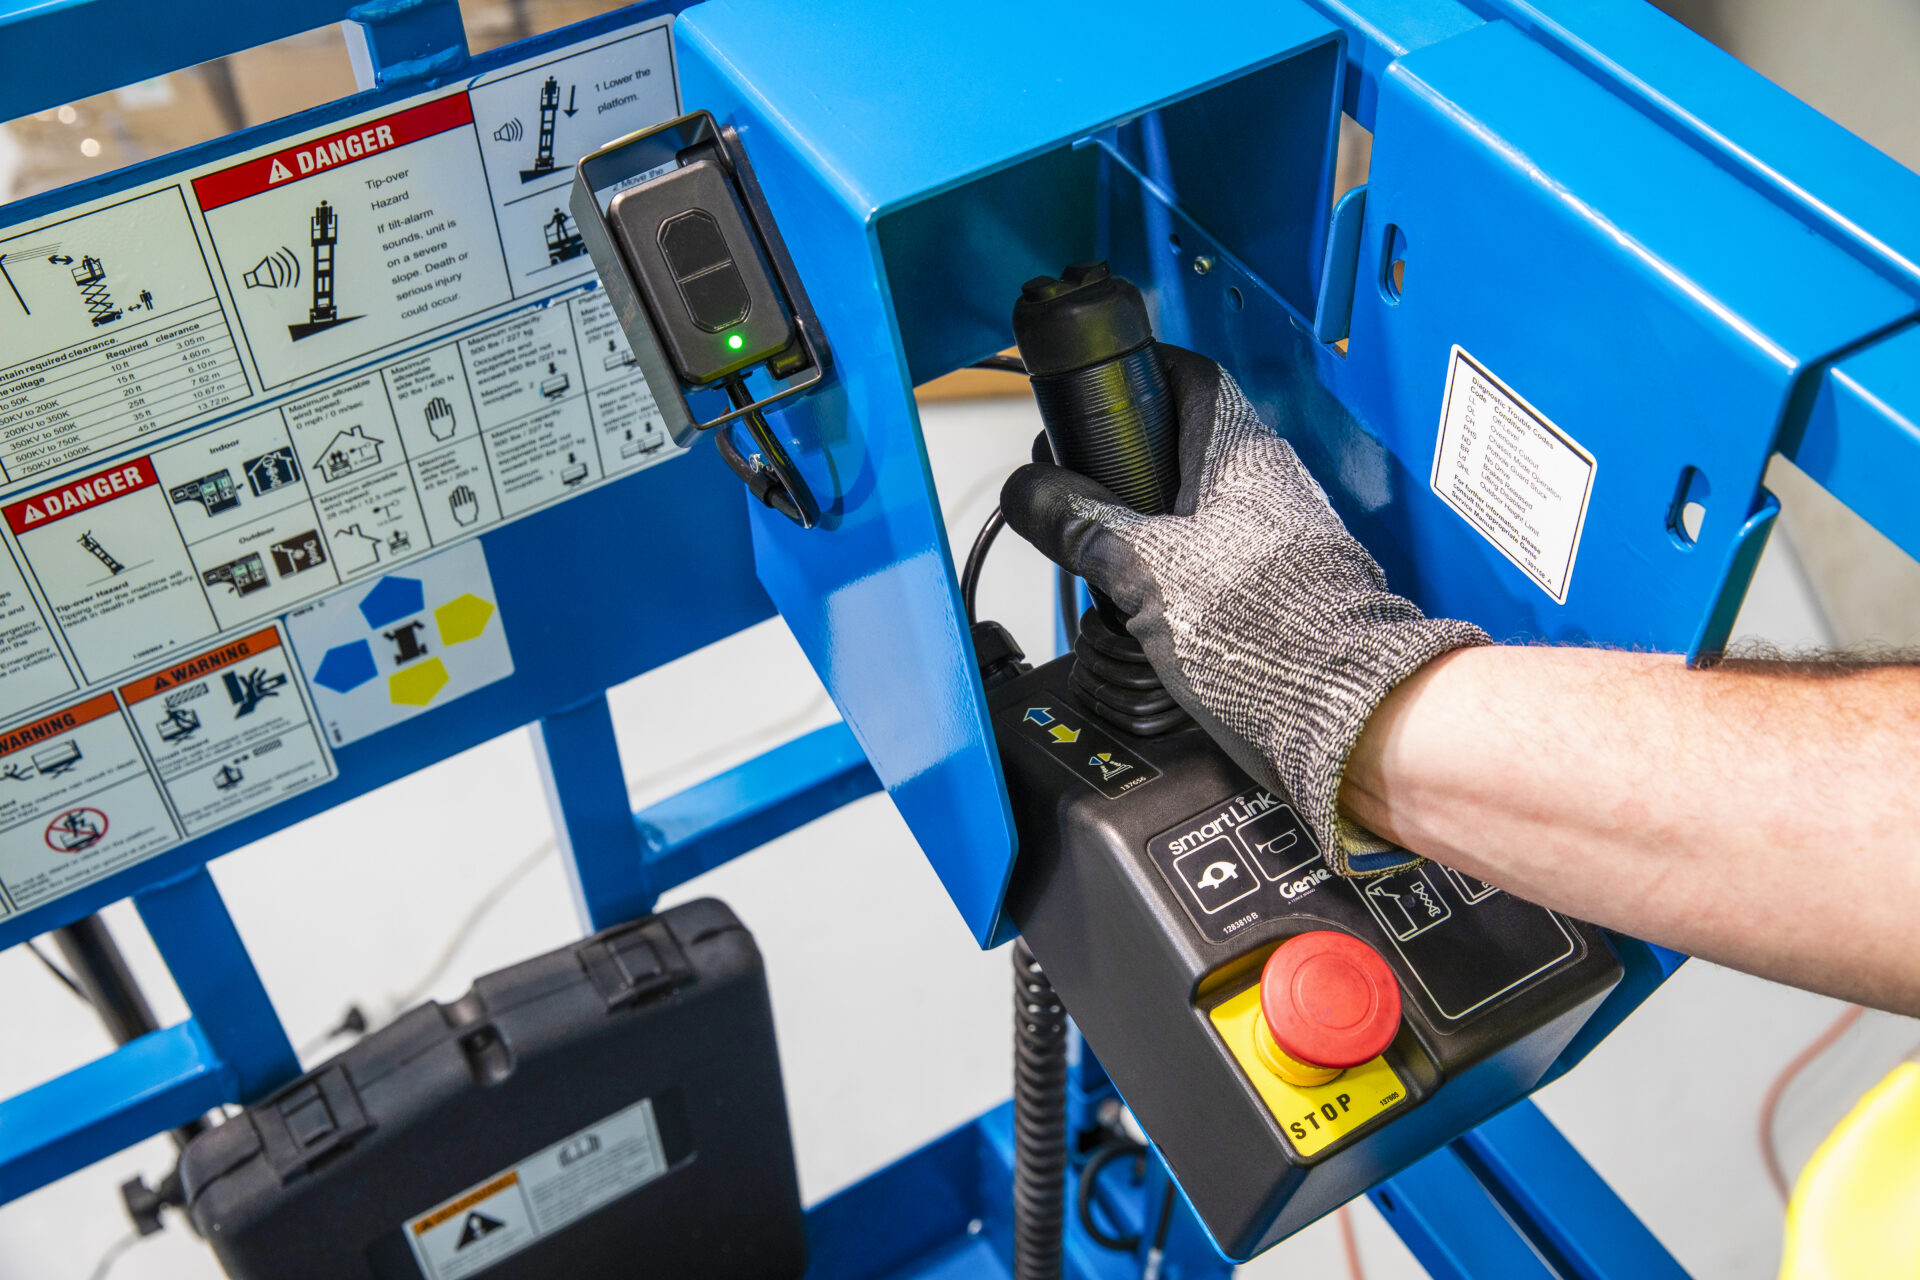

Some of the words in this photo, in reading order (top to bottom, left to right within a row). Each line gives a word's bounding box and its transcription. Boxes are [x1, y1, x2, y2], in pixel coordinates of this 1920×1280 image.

[595, 83, 600, 92] 1
[603, 74, 632, 90] Lower
[635, 68, 650, 79] the
[597, 93, 637, 114] platform.
[296, 124, 394, 173] DANGER
[365, 169, 408, 189] Tip-over
[370, 190, 409, 210] Hazard
[377, 223, 384, 233] If
[388, 209, 433, 230] tilt-alarm
[382, 232, 423, 251] sounds,
[425, 222, 445, 235] unit
[447, 220, 456, 228] is
[386, 258, 400, 268] on
[403, 254, 410, 262] a
[412, 241, 447, 259] severe
[391, 270, 419, 284] slope.
[424, 256, 456, 272] Death
[458, 251, 468, 261] or
[396, 282, 433, 301] serious
[434, 272, 461, 287] injury
[400, 302, 428, 319] could
[430, 293, 458, 308] occur.
[25, 353, 67, 372] required
[68, 338, 118, 358] clearance.
[105, 339, 148, 360] Required
[155, 323, 199, 342] clearance
[111, 363, 122, 371] 10
[176, 337, 195, 349] 3.05
[117, 375, 128, 384] 15
[182, 350, 201, 360] 4.60
[192, 374, 209, 385] 7.62
[211, 371, 220, 379] m
[8, 377, 44, 392] voltage
[122, 387, 133, 396] 20
[288, 394, 329, 413] Maximum
[332, 379, 370, 397] allowable
[10, 395, 29, 407] 50K
[34, 399, 59, 413] 200K
[133, 412, 144, 420] 35
[216, 383, 225, 391] m
[138, 424, 149, 432] 45
[220, 395, 229, 403] m
[292, 409, 312, 421] wind
[1470, 385, 1486, 403] Code
[1494, 405, 1525, 435] Condition
[1471, 376, 1505, 408] Diagnostic
[1507, 406, 1531, 430] Trouble
[1532, 428, 1553, 449] Codes
[3, 422, 34, 438] 200KV
[45, 410, 70, 423] 350K
[9, 434, 39, 450] 350KV
[53, 421, 77, 435] 500K
[304, 416, 323, 426] mph
[1466, 404, 1475, 416] OL
[1490, 425, 1517, 452] Overload
[1518, 449, 1539, 470] Cutout
[15, 446, 45, 462] 500KV
[57, 434, 80, 447] 750K
[22, 458, 50, 474] 750KV
[63, 445, 90, 459] 1000K
[209, 439, 239, 454] Indoor
[1465, 414, 1475, 426] CH
[1488, 434, 1511, 458] Chassis
[1513, 455, 1530, 474] Mode
[1531, 471, 1561, 500] Operation
[1484, 454, 1493, 465] No
[1494, 462, 1510, 480] Drive
[1486, 444, 1508, 467] Pothole
[1510, 465, 1529, 484] Guard
[1530, 482, 1547, 499] Stuck
[43, 466, 143, 515] DANGER
[1479, 481, 1503, 504] Outdoor
[1504, 503, 1523, 521] Height
[1481, 471, 1499, 491] Lifting
[1499, 487, 1525, 513] Disabled
[1483, 462, 1503, 484] Brakes
[1504, 481, 1532, 510] Released
[1451, 490, 1472, 512] Service
[1473, 509, 1495, 533] Manual.
[1453, 483, 1474, 504] consult
[1475, 501, 1484, 513] the
[1485, 512, 1518, 543] appropriate
[1519, 541, 1536, 560] Genie
[1454, 474, 1464, 485] For
[1465, 483, 1484, 503] further
[1485, 501, 1519, 537] information,
[1521, 535, 1540, 554] please
[238, 527, 274, 544] Outdoor
[55, 595, 93, 613] Tip-over
[95, 581, 128, 597] Hazard
[59, 606, 92, 621] Tipping
[93, 598, 112, 609] over
[114, 592, 128, 600] the
[130, 577, 166, 594] machine
[169, 570, 182, 579] will
[63, 615, 87, 628] result
[99, 602, 124, 614] death
[138, 585, 168, 599] serious
[170, 642, 249, 682] WARNING
[1279, 868, 1331, 898] Genie
[1289, 1093, 1350, 1139] STOP
